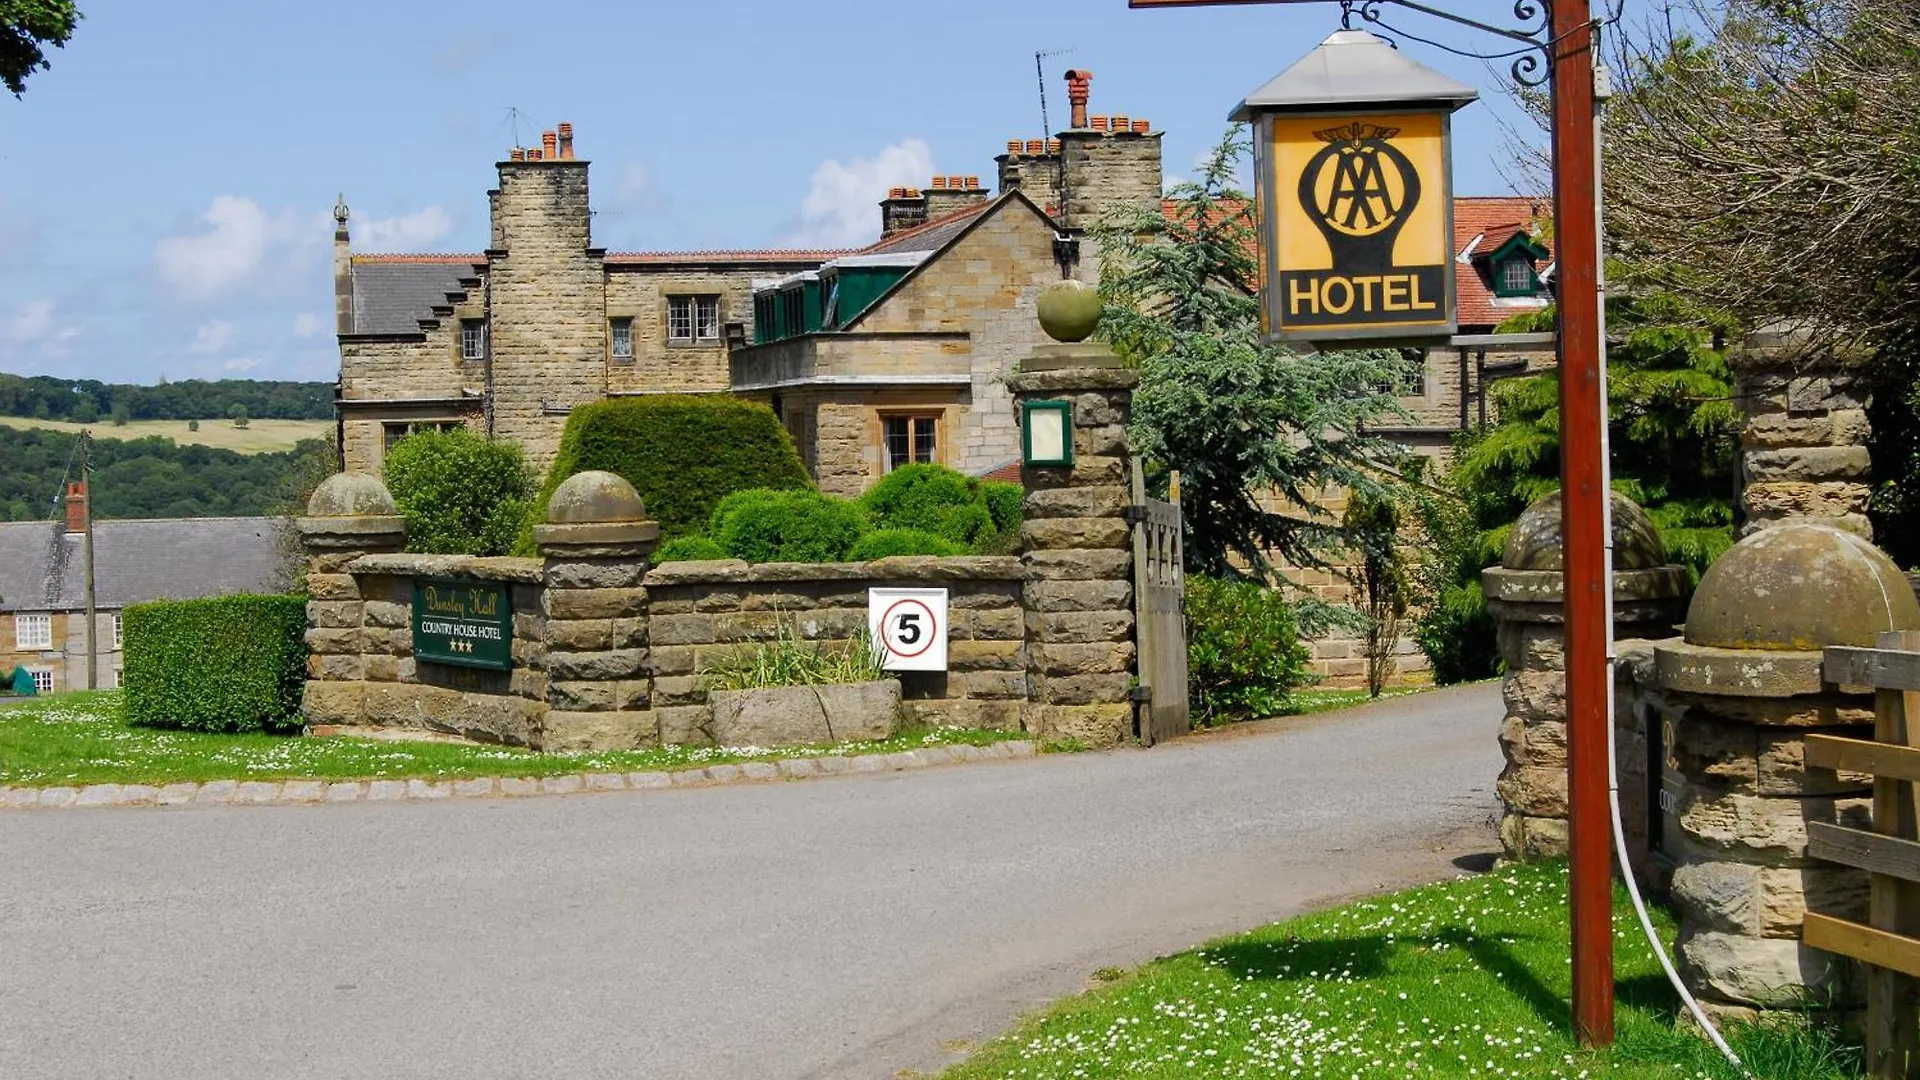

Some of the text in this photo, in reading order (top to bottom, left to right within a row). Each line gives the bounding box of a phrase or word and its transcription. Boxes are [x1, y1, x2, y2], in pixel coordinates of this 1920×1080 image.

[1324, 148, 1398, 229] AA
[1289, 274, 1437, 315] HOTEL
[424, 586, 498, 621] Dunsley Hall
[421, 621, 502, 640] COUNTRY HOUSE HOTEL
[898, 613, 921, 645] 5
